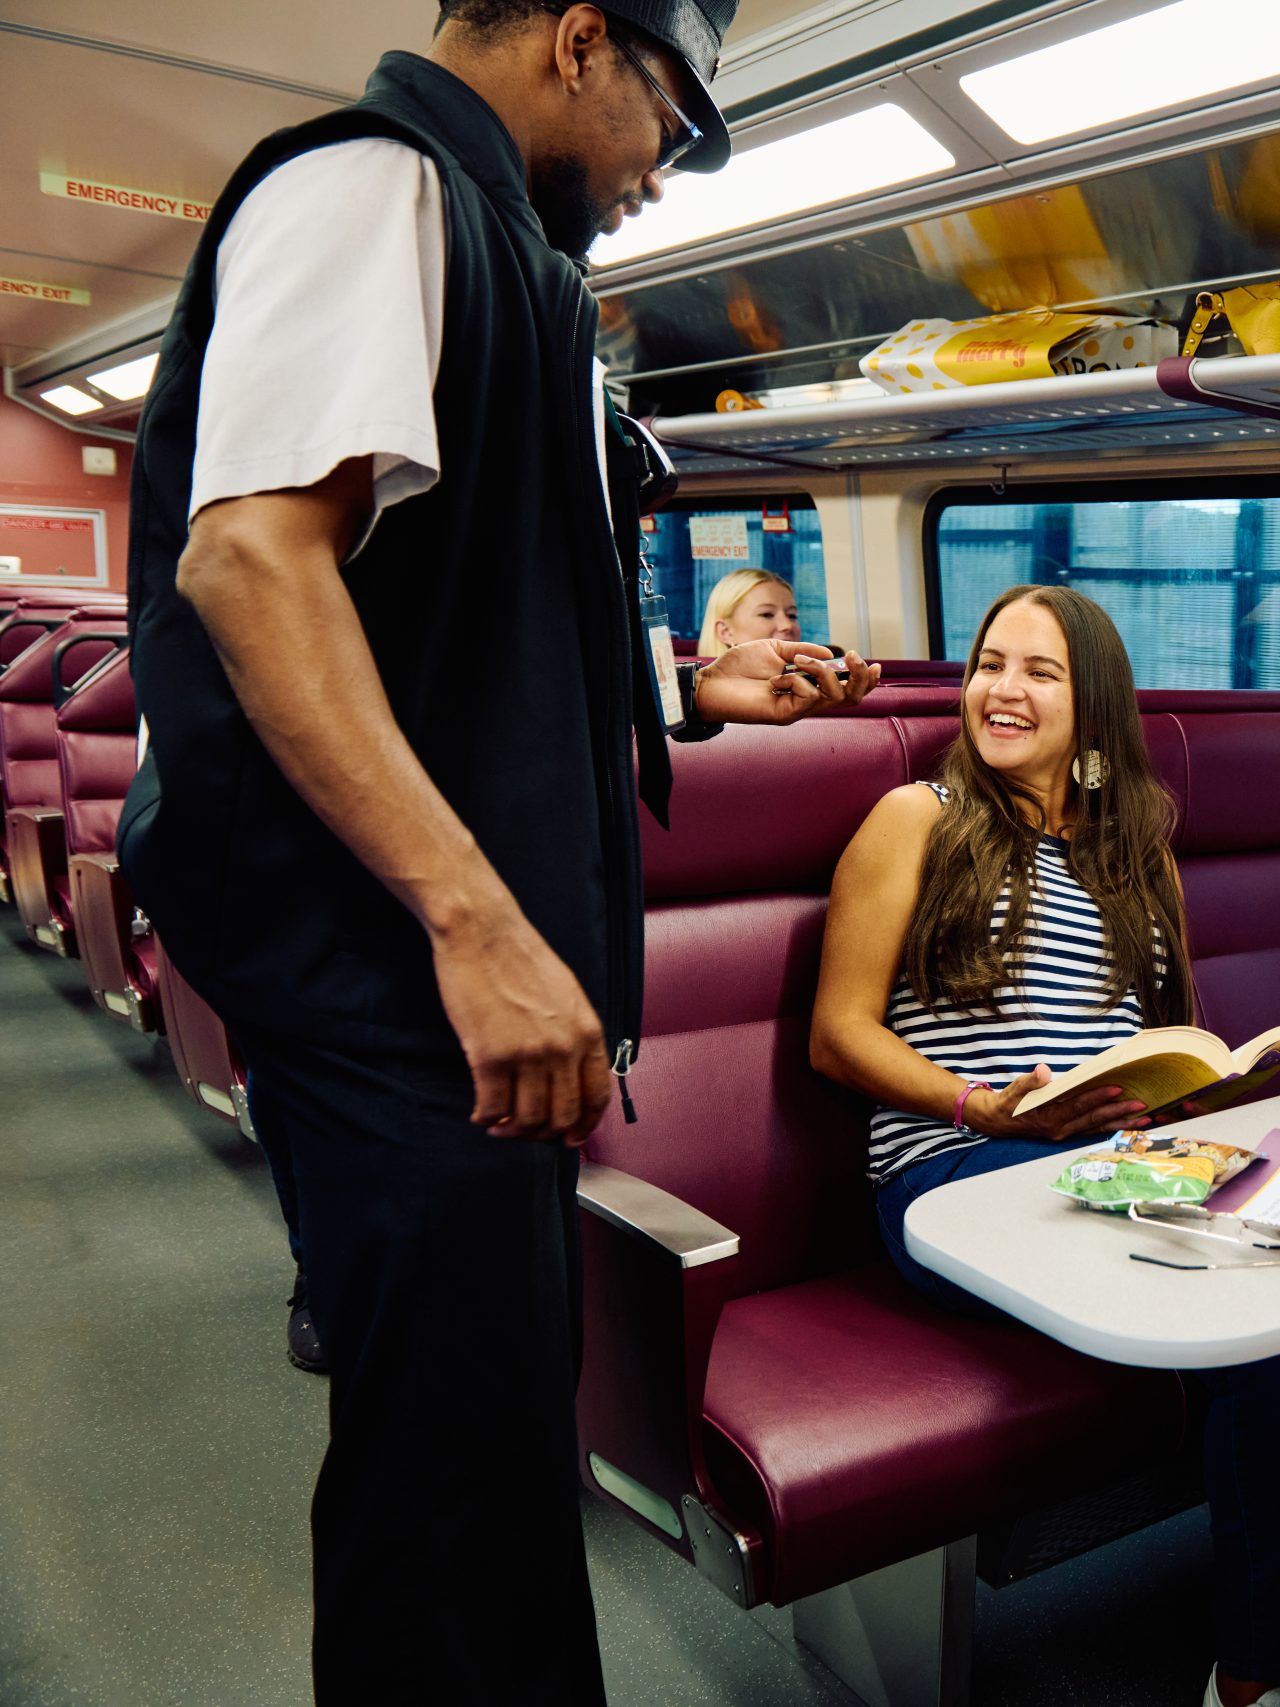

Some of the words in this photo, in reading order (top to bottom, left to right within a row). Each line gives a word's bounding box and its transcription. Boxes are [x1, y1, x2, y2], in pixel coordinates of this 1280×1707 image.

[66, 181, 177, 214] EMERGENCY
[183, 203, 213, 220] EXI
[0, 280, 37, 295] ENCY
[42, 286, 71, 300] EXIT
[691, 546, 731, 557] EMERGENCY
[733, 545, 747, 557] EXIT
